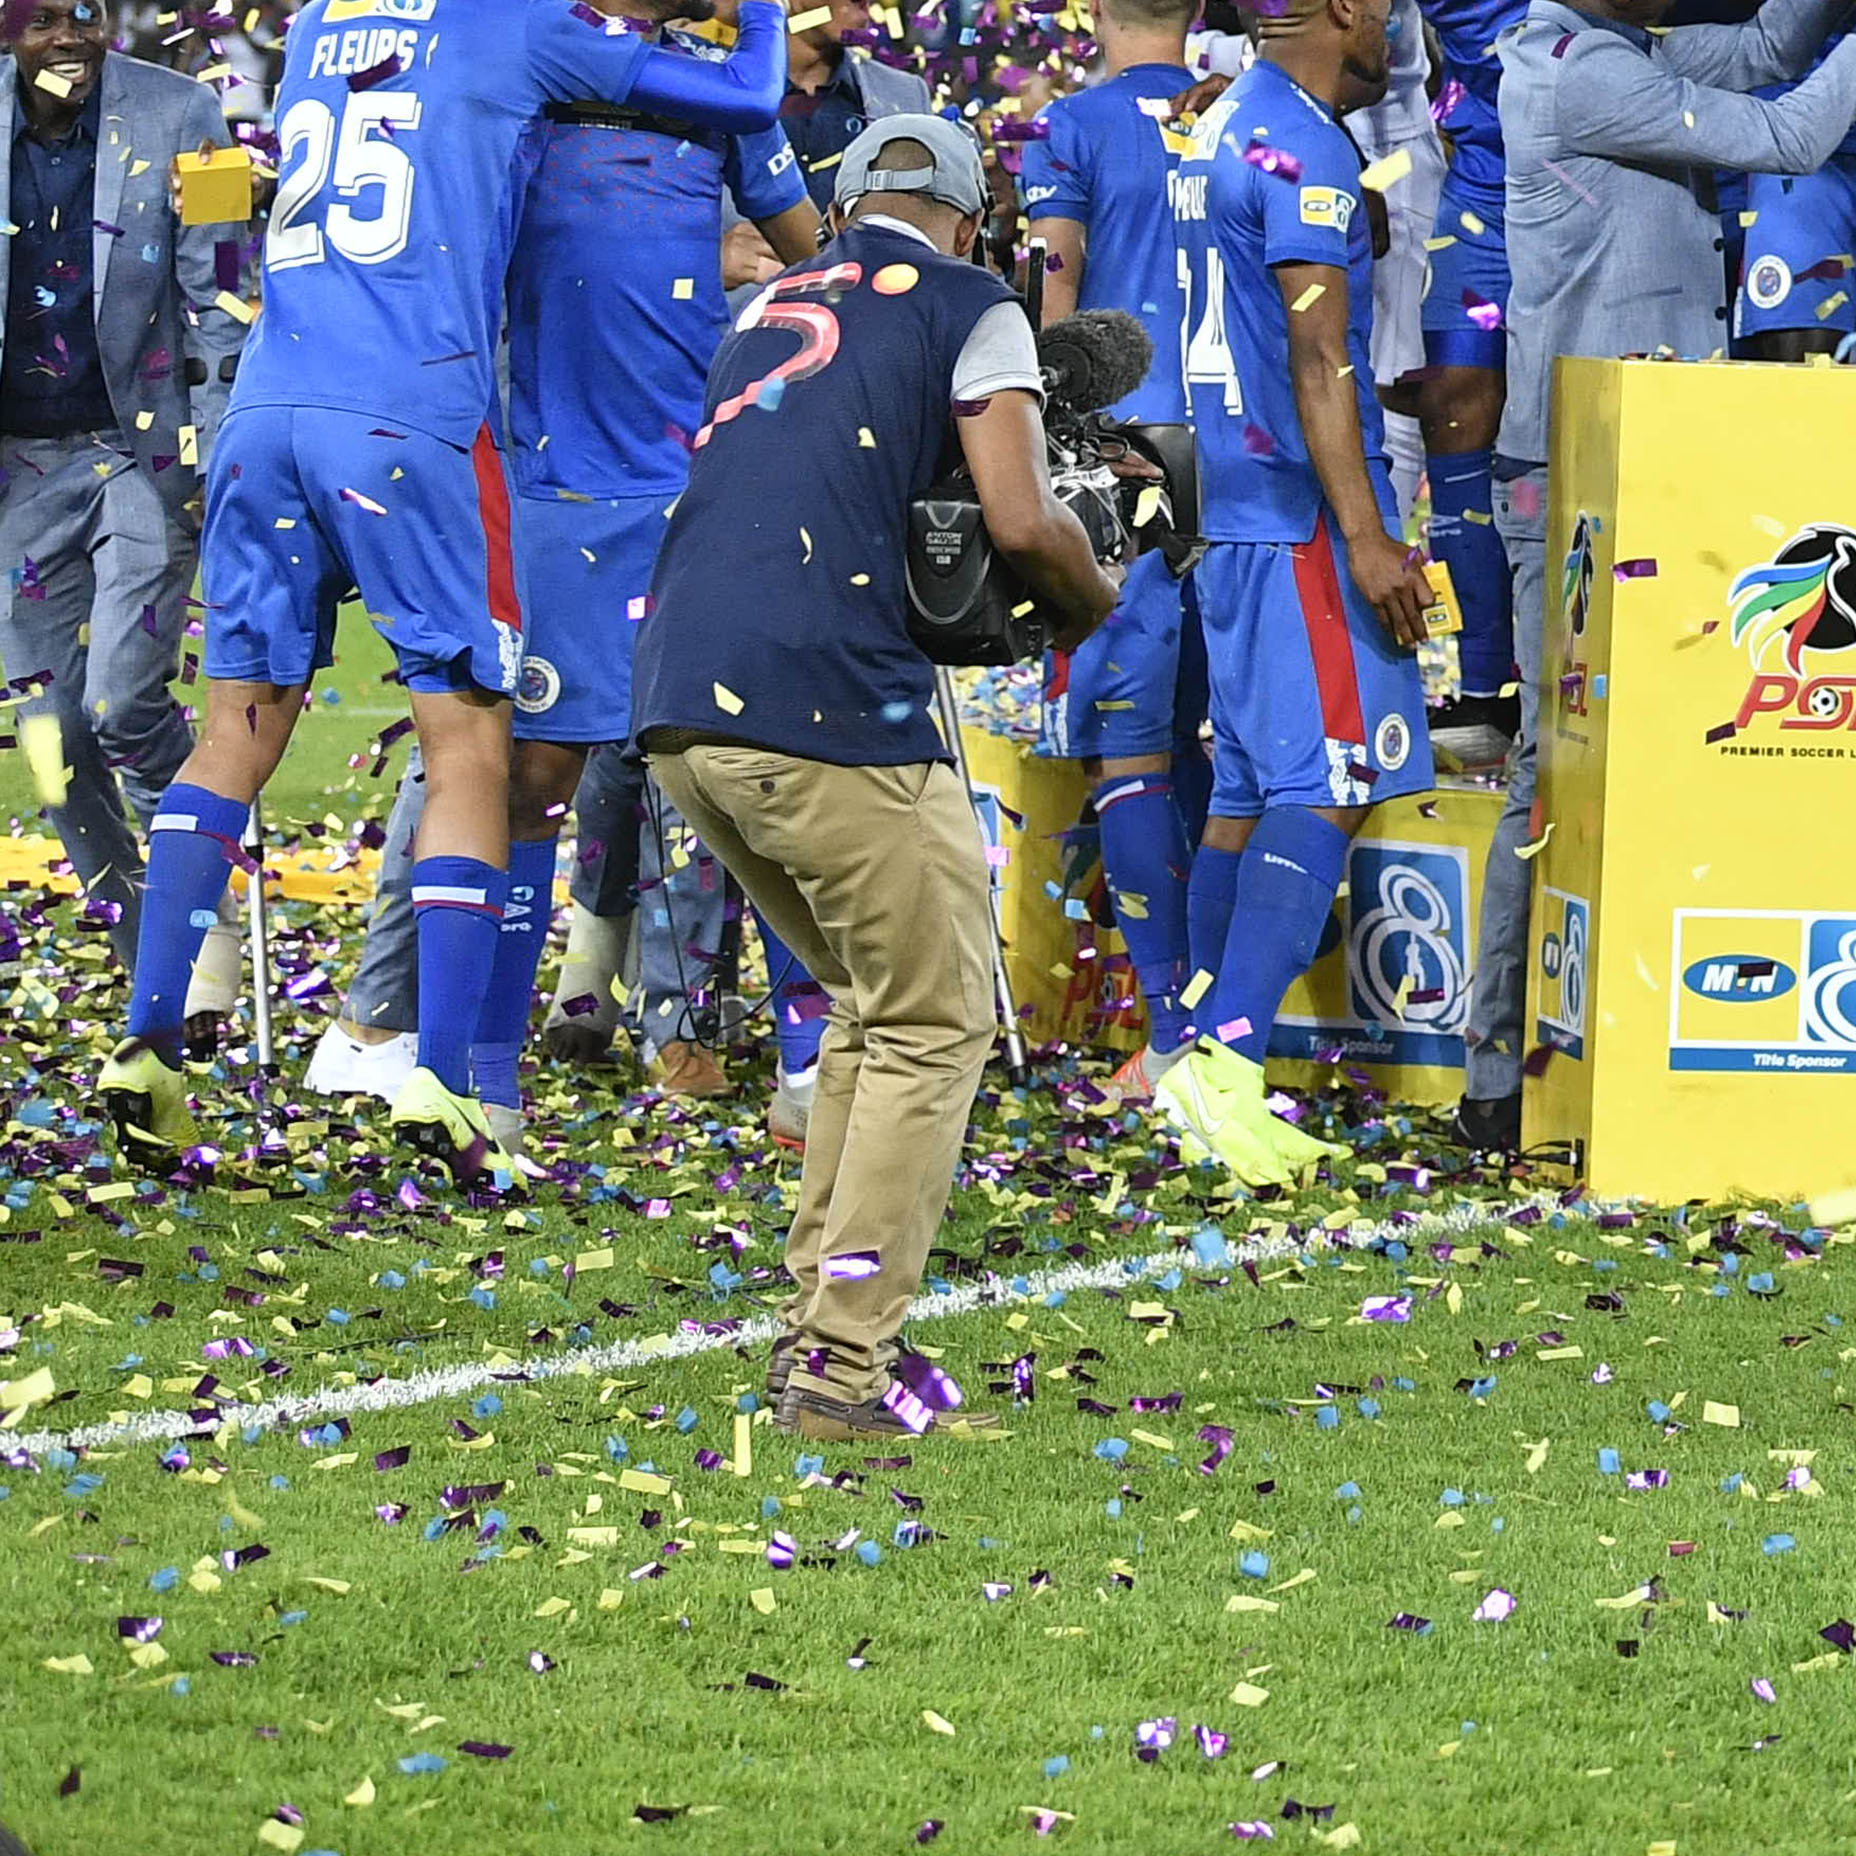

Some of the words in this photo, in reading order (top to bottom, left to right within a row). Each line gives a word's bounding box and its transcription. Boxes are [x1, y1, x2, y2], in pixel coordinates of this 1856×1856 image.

[265, 90, 423, 274] 25
[1720, 745, 1785, 758] PREMIER
[1790, 746, 1845, 759] SOCCER
[1753, 1052, 1785, 1069] Title
[1786, 1053, 1847, 1071] Sponsor
